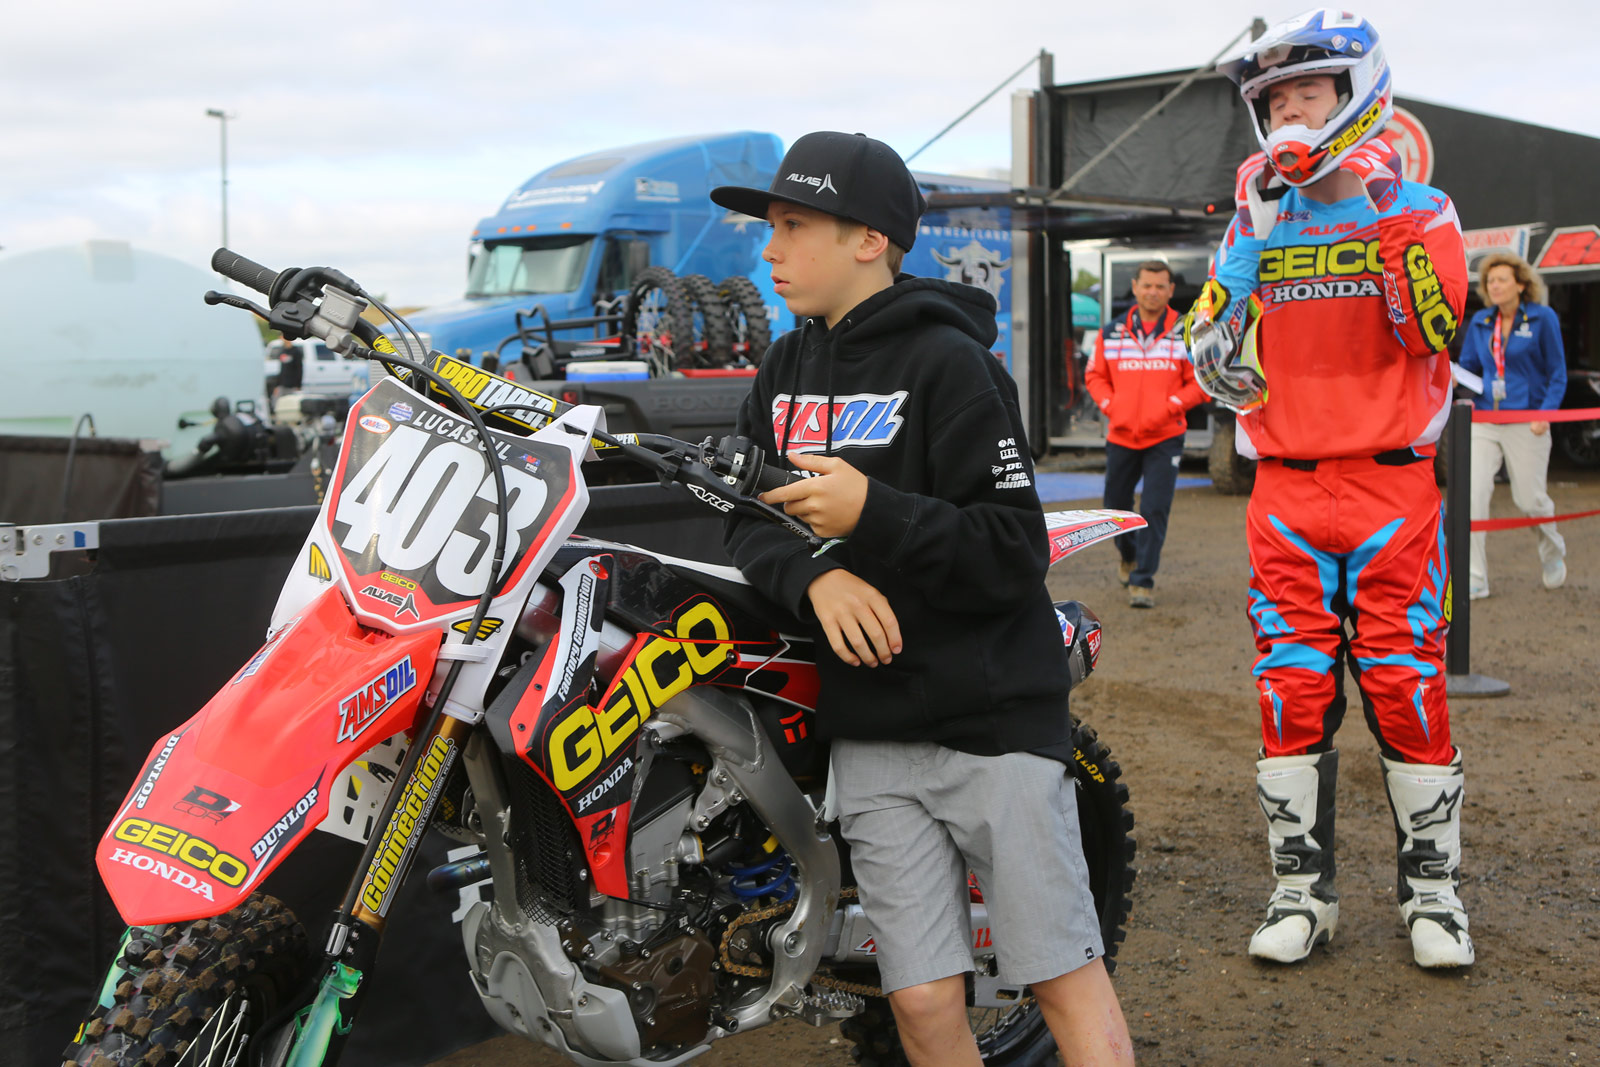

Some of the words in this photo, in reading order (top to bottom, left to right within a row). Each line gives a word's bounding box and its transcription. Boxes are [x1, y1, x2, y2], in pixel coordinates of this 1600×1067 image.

[1328, 102, 1382, 157] GEICO
[1272, 279, 1382, 304] HONDA
[1406, 244, 1459, 353] GEIC
[1117, 359, 1178, 371] HONDA
[412, 410, 479, 445] LUCAS
[649, 396, 743, 411] HOND
[335, 424, 549, 597] 403
[687, 483, 735, 513] ARC
[380, 572, 417, 591] GEICO
[337, 655, 417, 743] AMSOIL
[549, 602, 734, 791] GEICO
[135, 735, 180, 810] DUNLOP
[578, 757, 633, 813] HONDA
[251, 787, 319, 860] DUNLOP
[109, 848, 215, 902] HONDA
[112, 819, 250, 889] GEICO
